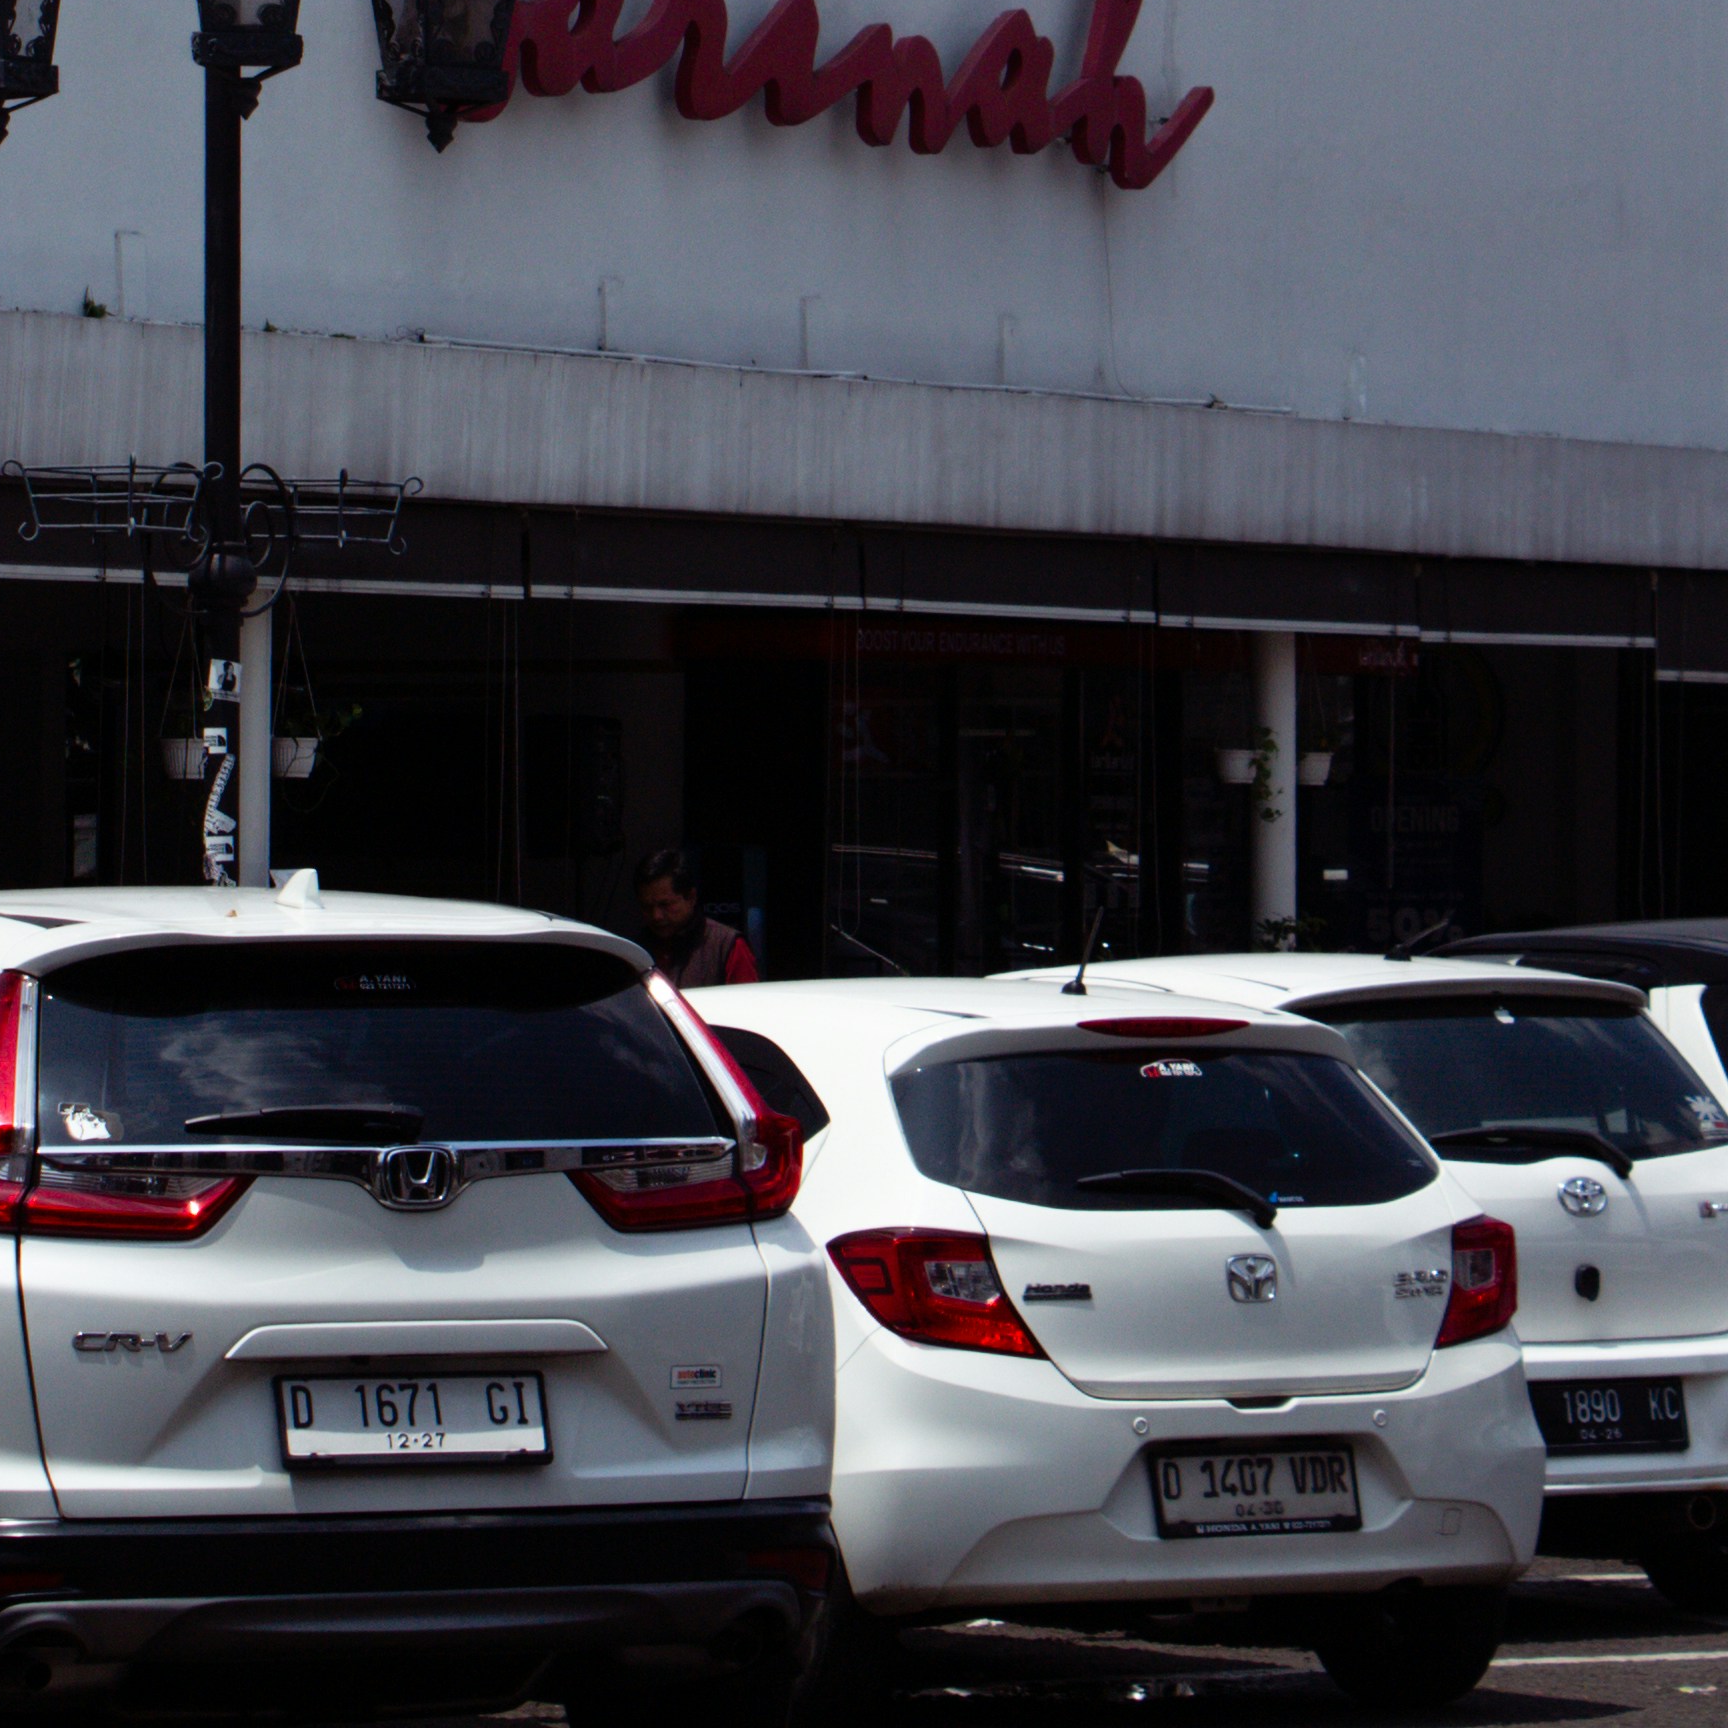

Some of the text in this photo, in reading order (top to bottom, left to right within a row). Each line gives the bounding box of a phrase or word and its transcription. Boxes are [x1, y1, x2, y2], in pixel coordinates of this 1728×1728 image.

[858, 628, 1067, 658] BOOST YOUR ENDURANCE WITH US
[73, 1331, 193, 1352] CR-V
[290, 1381, 530, 1429] D 1671 GI
[1562, 1386, 1680, 1424] 1890 KC
[1201, 1456, 1275, 1498] 1407
[1288, 1455, 1349, 1494] VDR
